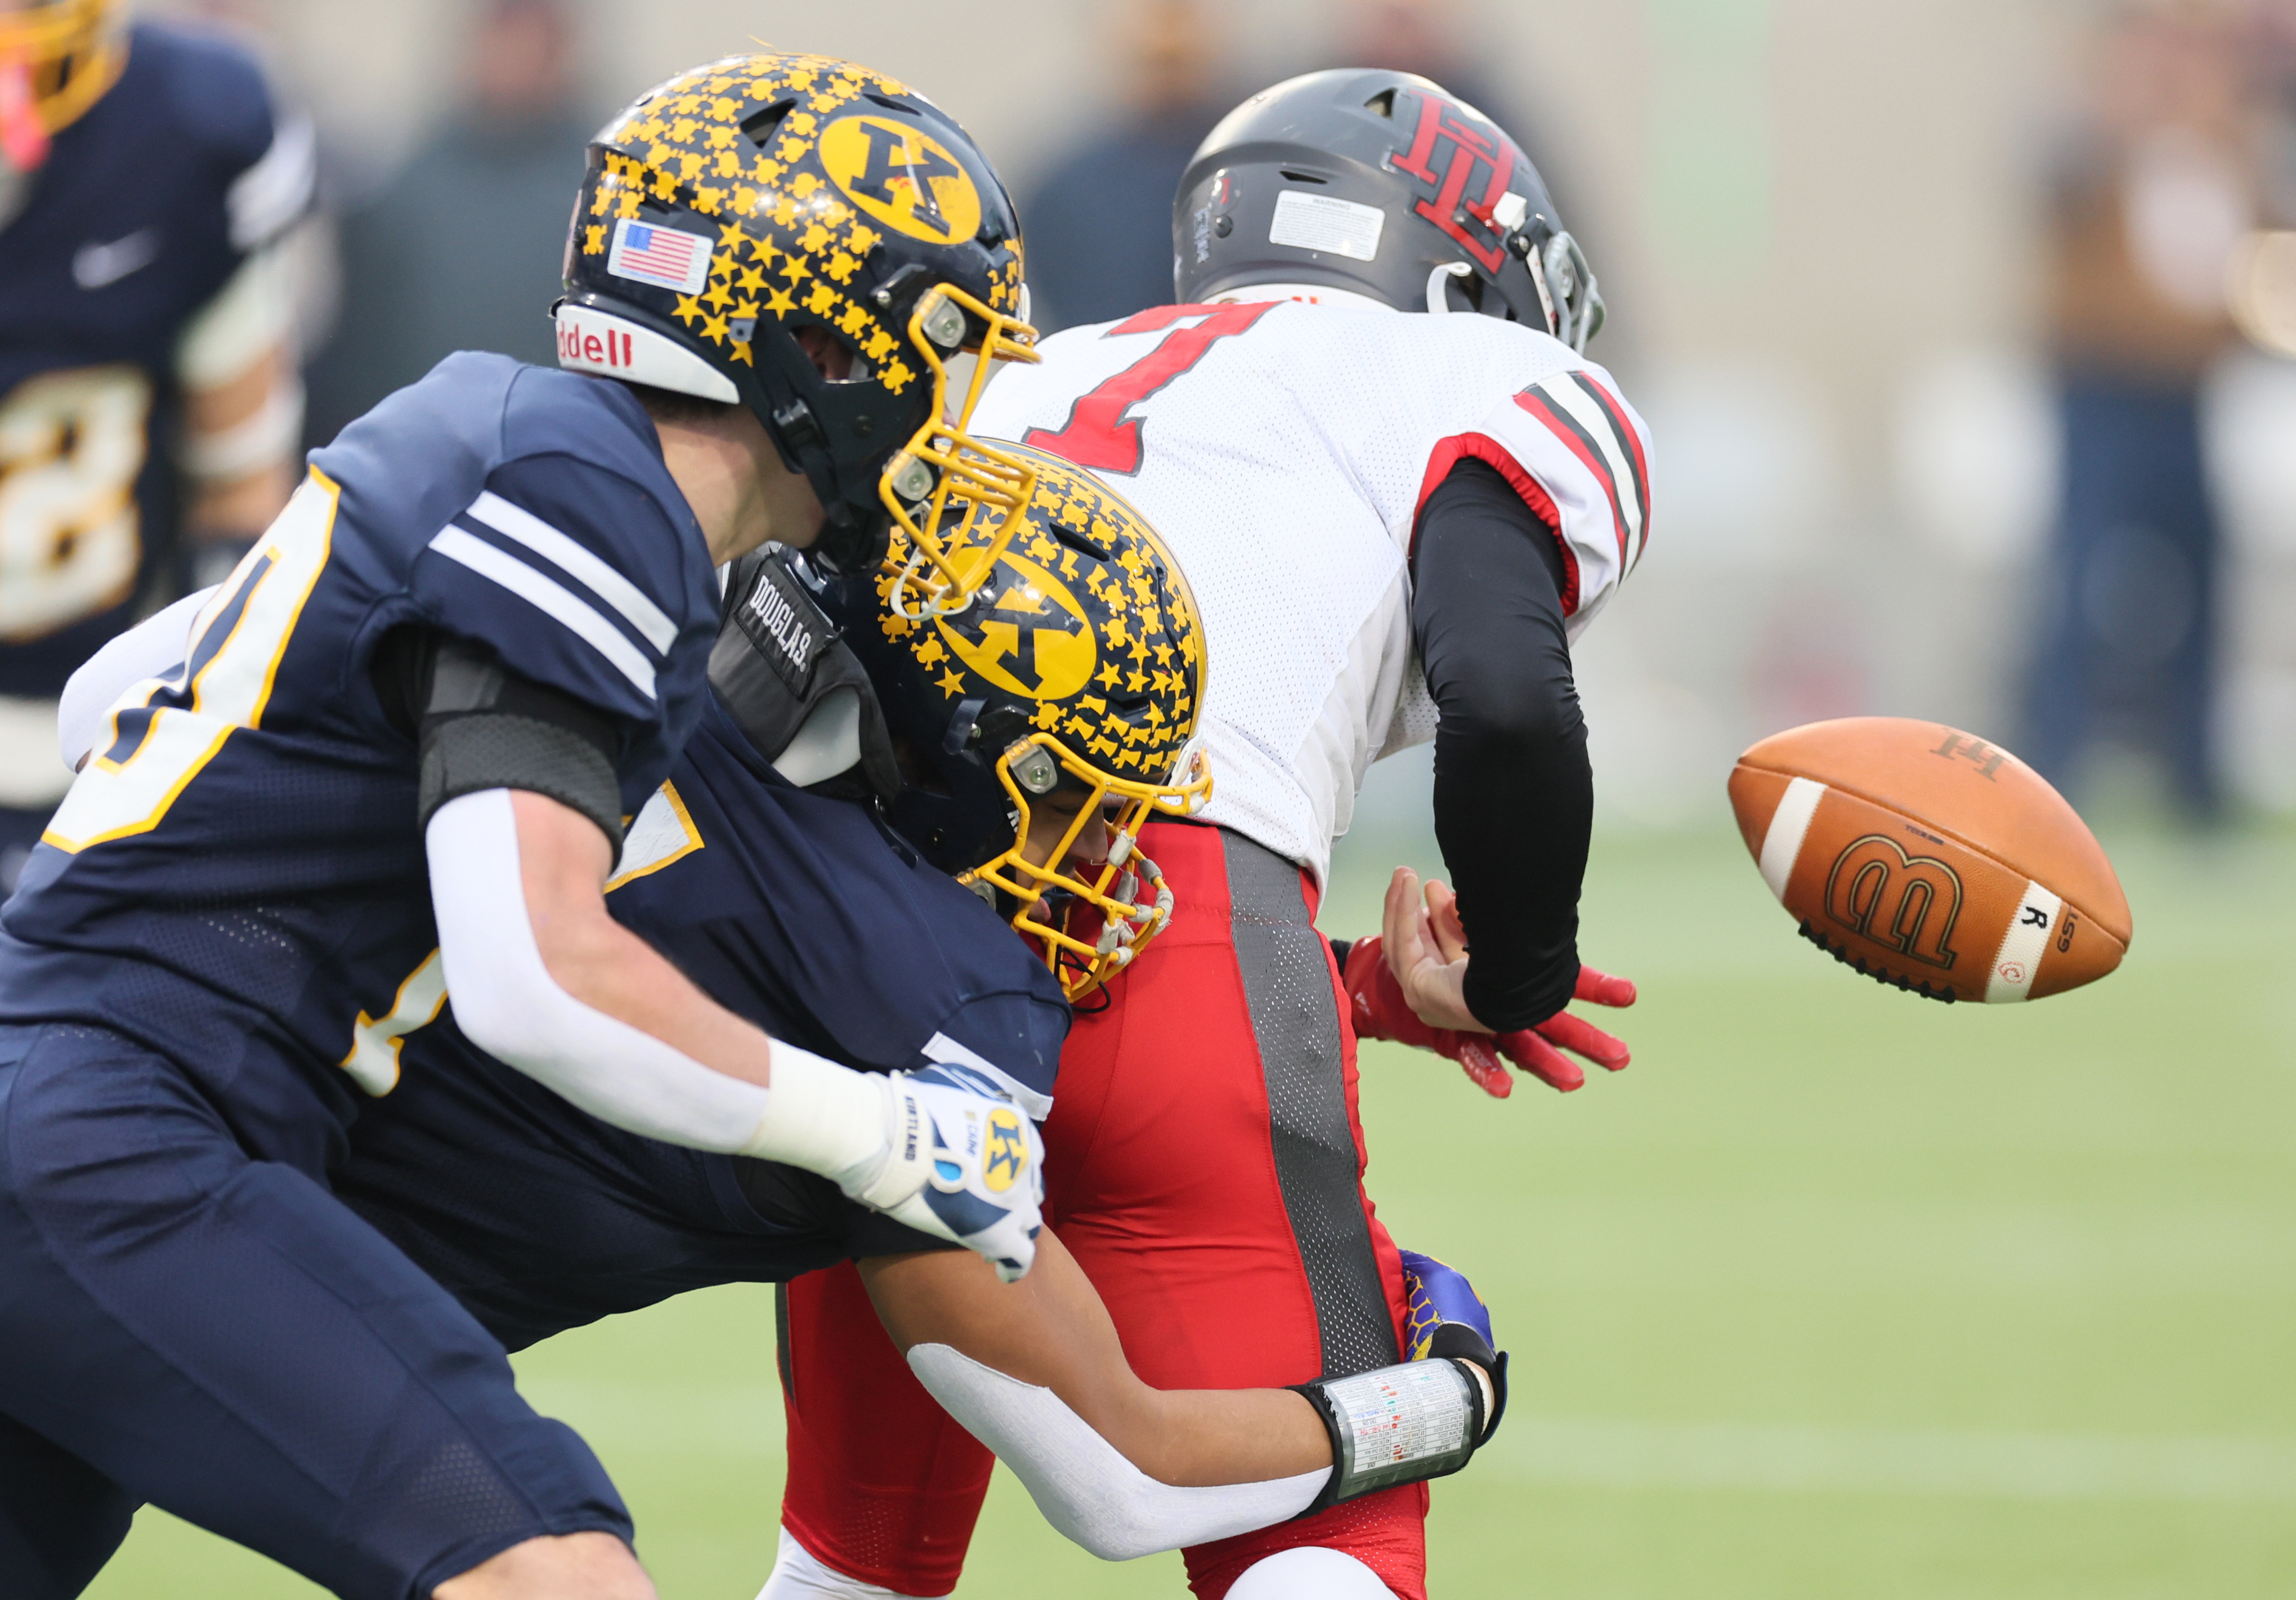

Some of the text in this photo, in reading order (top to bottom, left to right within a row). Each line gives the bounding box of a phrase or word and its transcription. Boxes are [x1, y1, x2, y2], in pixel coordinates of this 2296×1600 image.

[849, 121, 959, 238] K
[1313, 198, 1351, 211] WARNING
[1022, 300, 1289, 477] 7
[749, 575, 811, 667] DOUGLAS
[2022, 906, 2047, 928] R
[987, 1120, 1021, 1180] K
